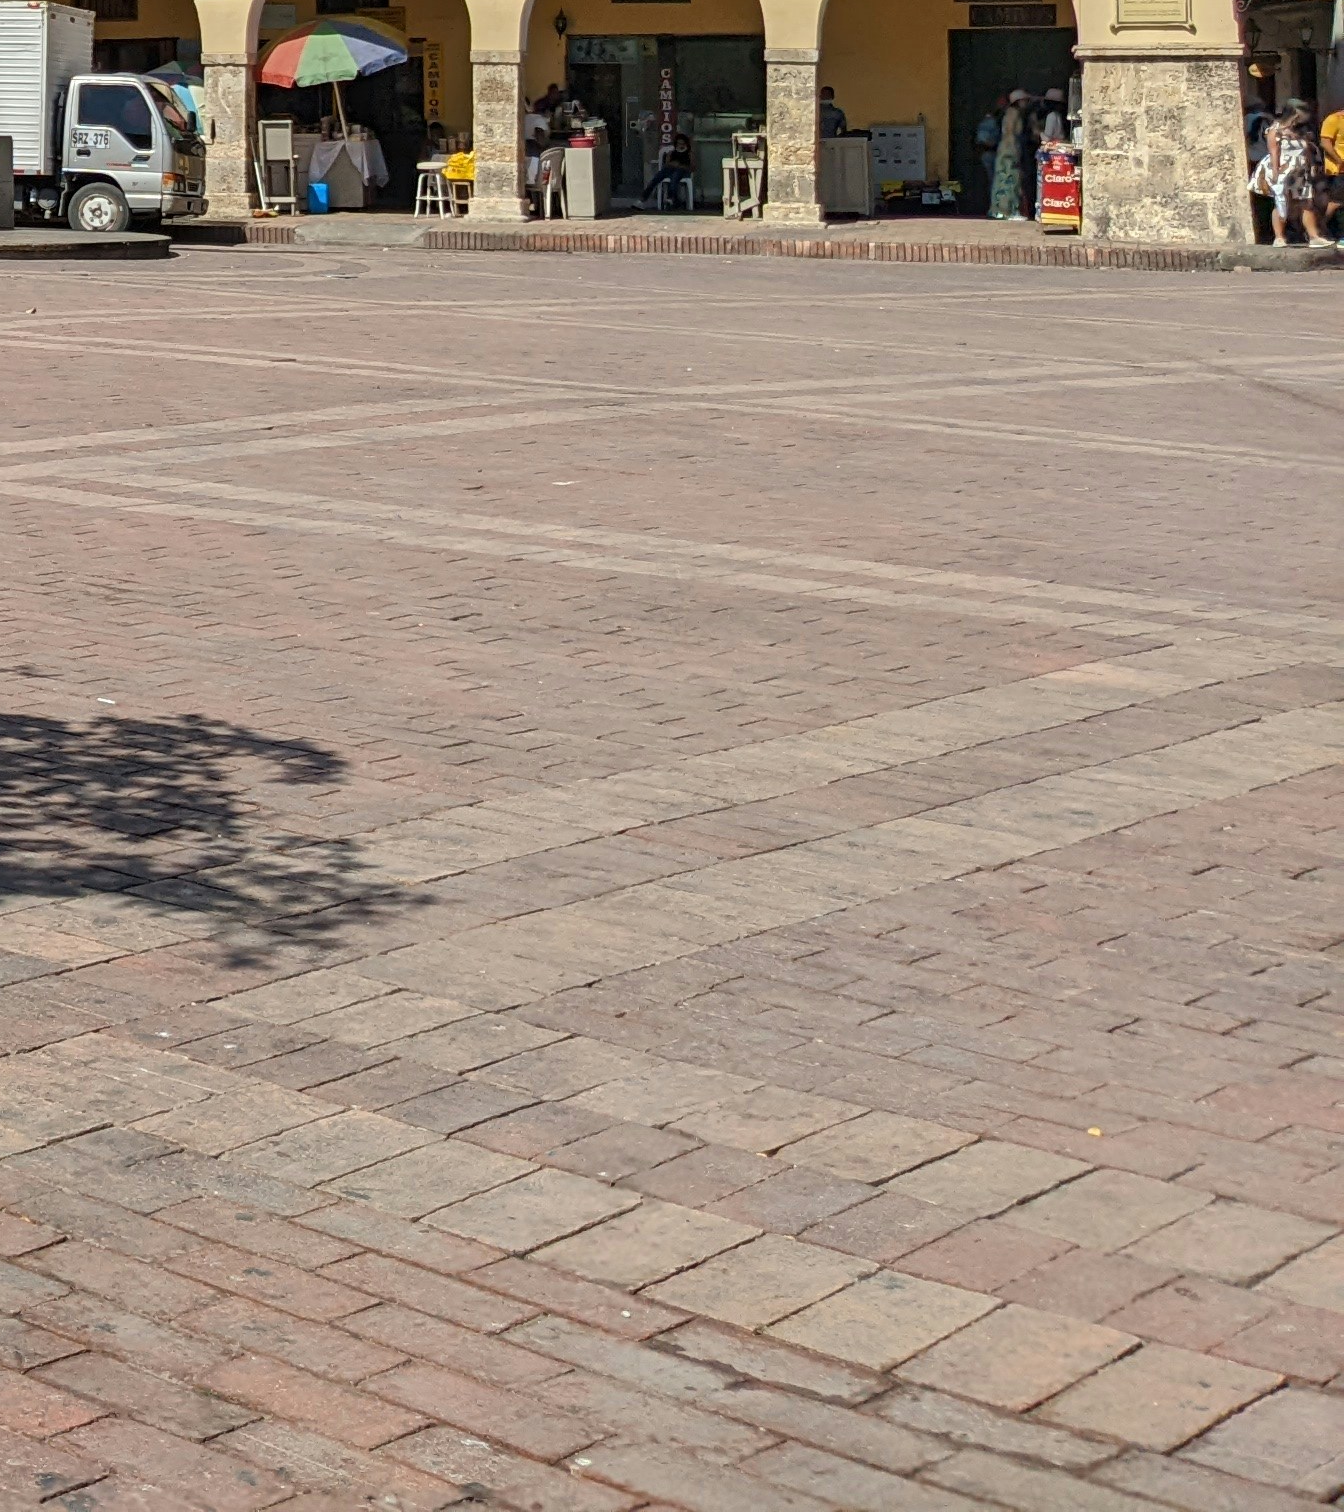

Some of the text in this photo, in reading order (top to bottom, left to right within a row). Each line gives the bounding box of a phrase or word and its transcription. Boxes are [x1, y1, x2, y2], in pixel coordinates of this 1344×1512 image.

[428, 53, 439, 120] CAMBIOS
[660, 68, 672, 144] CAMBIOS
[1044, 173, 1072, 183] Claro
[1043, 198, 1070, 208] Claro
